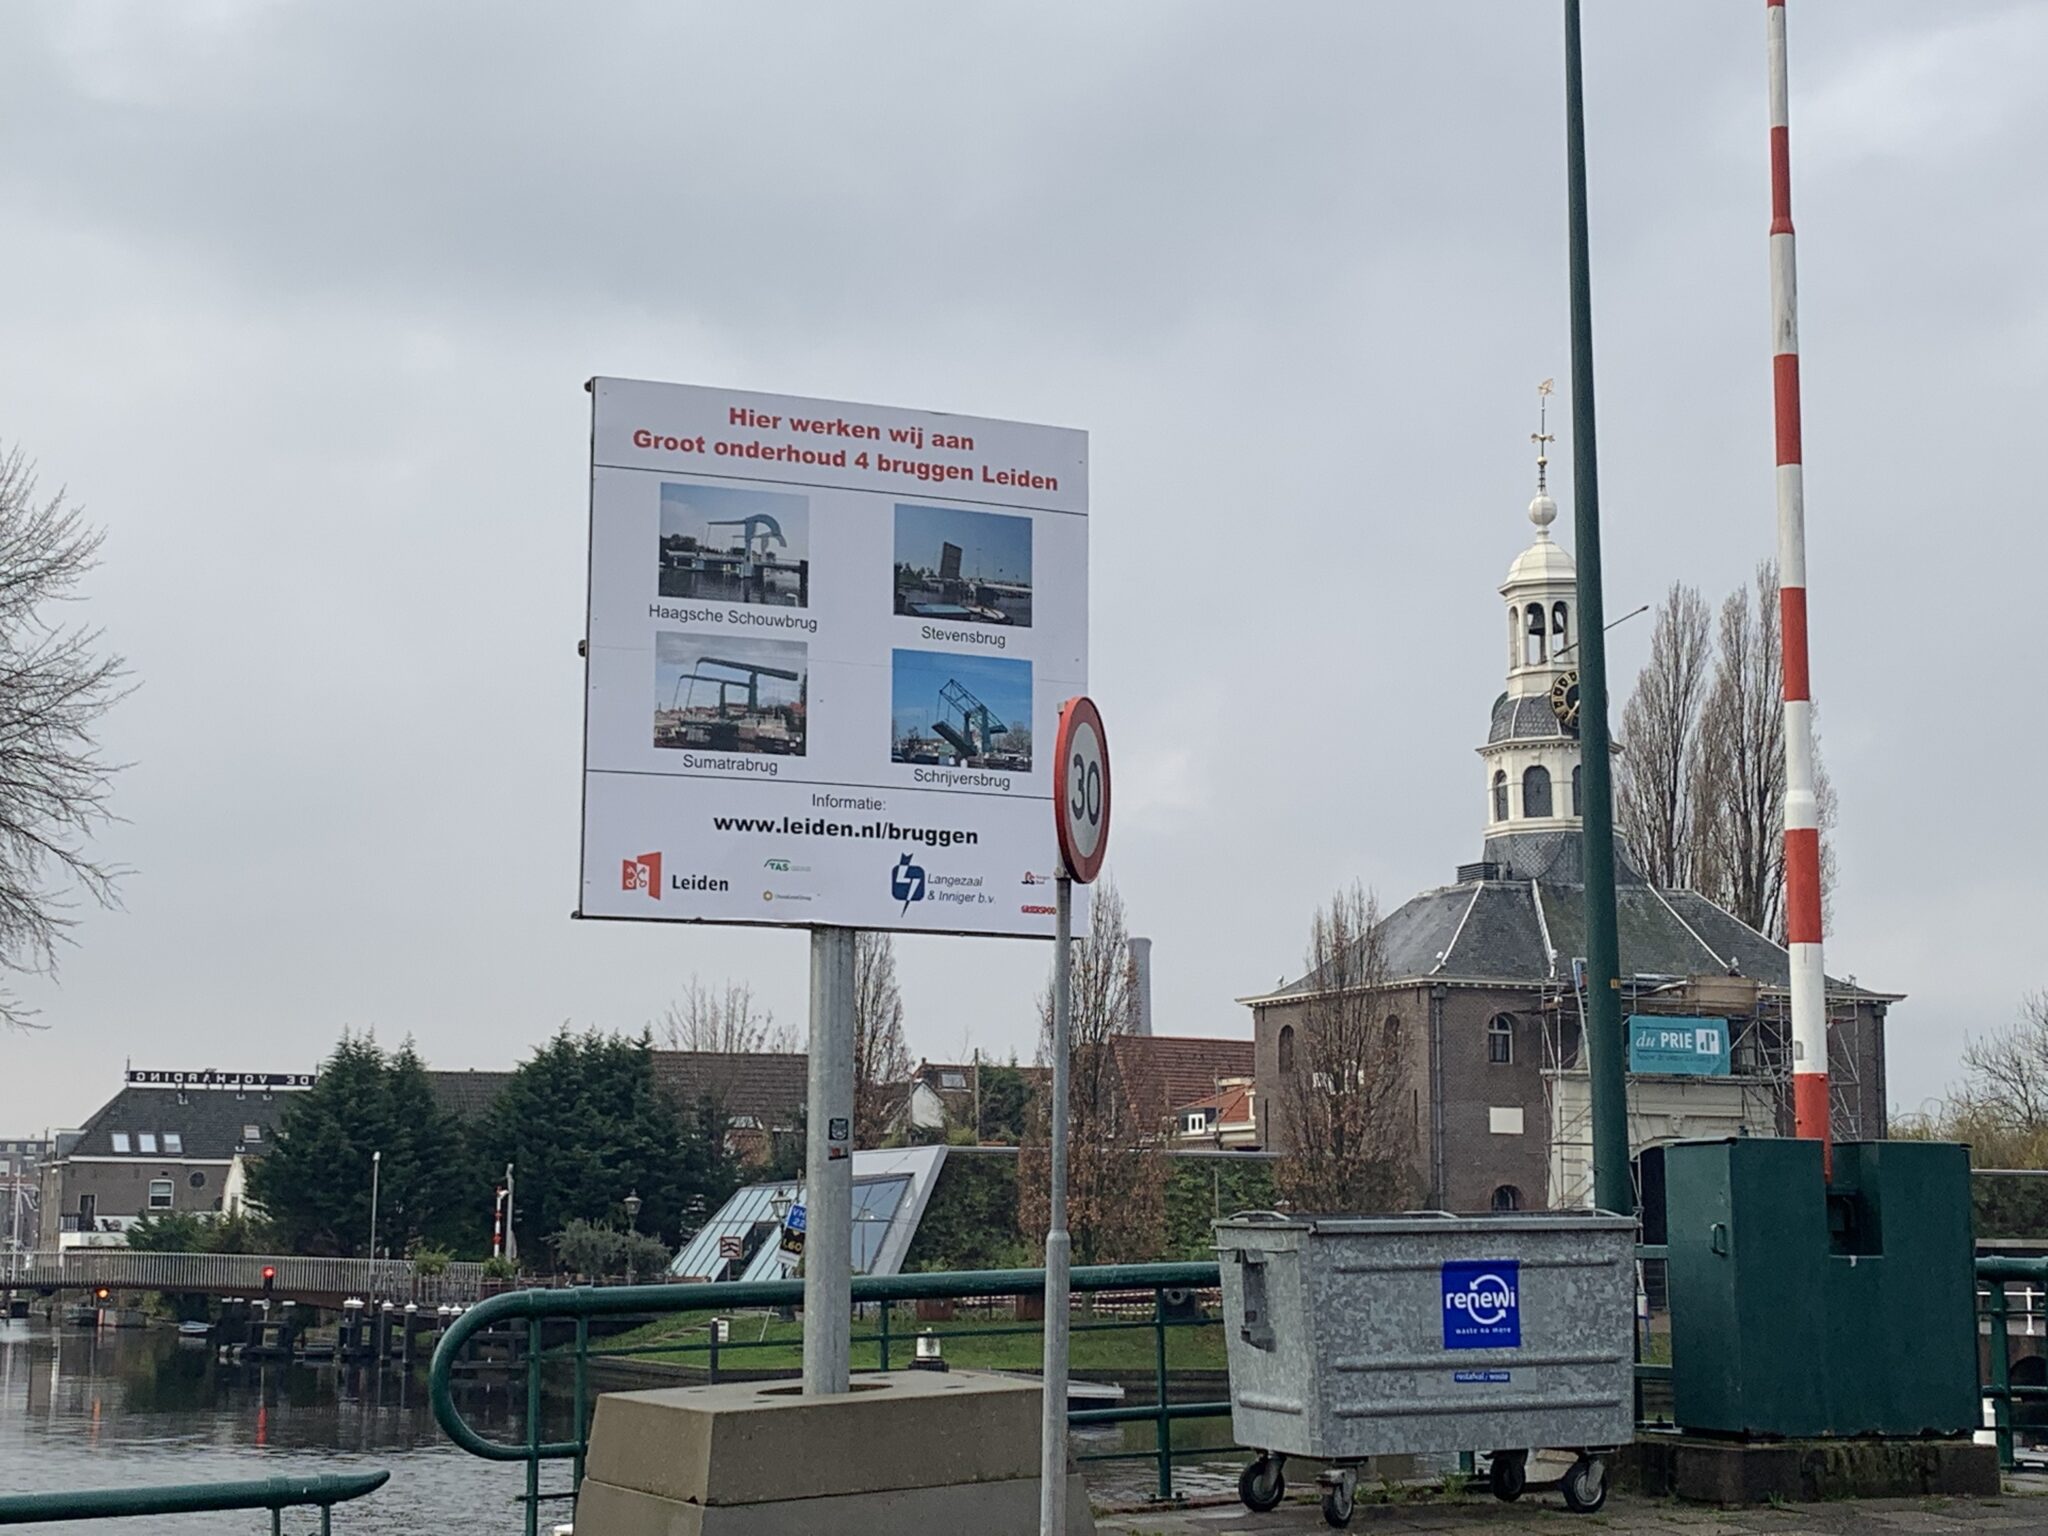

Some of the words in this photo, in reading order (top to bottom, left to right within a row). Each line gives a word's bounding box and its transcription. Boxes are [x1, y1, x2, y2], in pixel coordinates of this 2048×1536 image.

[728, 406, 782, 430] Hier
[789, 416, 881, 440] werken
[888, 426, 924, 451] wij
[932, 432, 975, 452] aan
[632, 429, 706, 454] Groot
[714, 440, 847, 468] onderhoud
[854, 451, 870, 470] 4
[877, 453, 974, 483] bruggen
[981, 465, 1059, 491] Leiden
[649, 604, 724, 624] Haagsche
[728, 610, 818, 633] Schouwbrug
[921, 626, 1006, 648] Stevensbrug
[682, 753, 778, 775] Sumatrabrug
[913, 767, 1011, 791] Schrijversbrug
[1071, 753, 1100, 826] 30
[812, 794, 886, 812] Informatie:
[713, 816, 978, 847] www.leiden.nl/bruggen
[769, 862, 789, 872] TAS
[672, 874, 729, 892] Leiden
[927, 873, 983, 888] Langezaal
[927, 890, 935, 901] &
[939, 891, 976, 905] Inniger
[1635, 1031, 1656, 1048] du
[1660, 1031, 1693, 1049] PRIE
[1445, 1286, 1516, 1309] renewi
